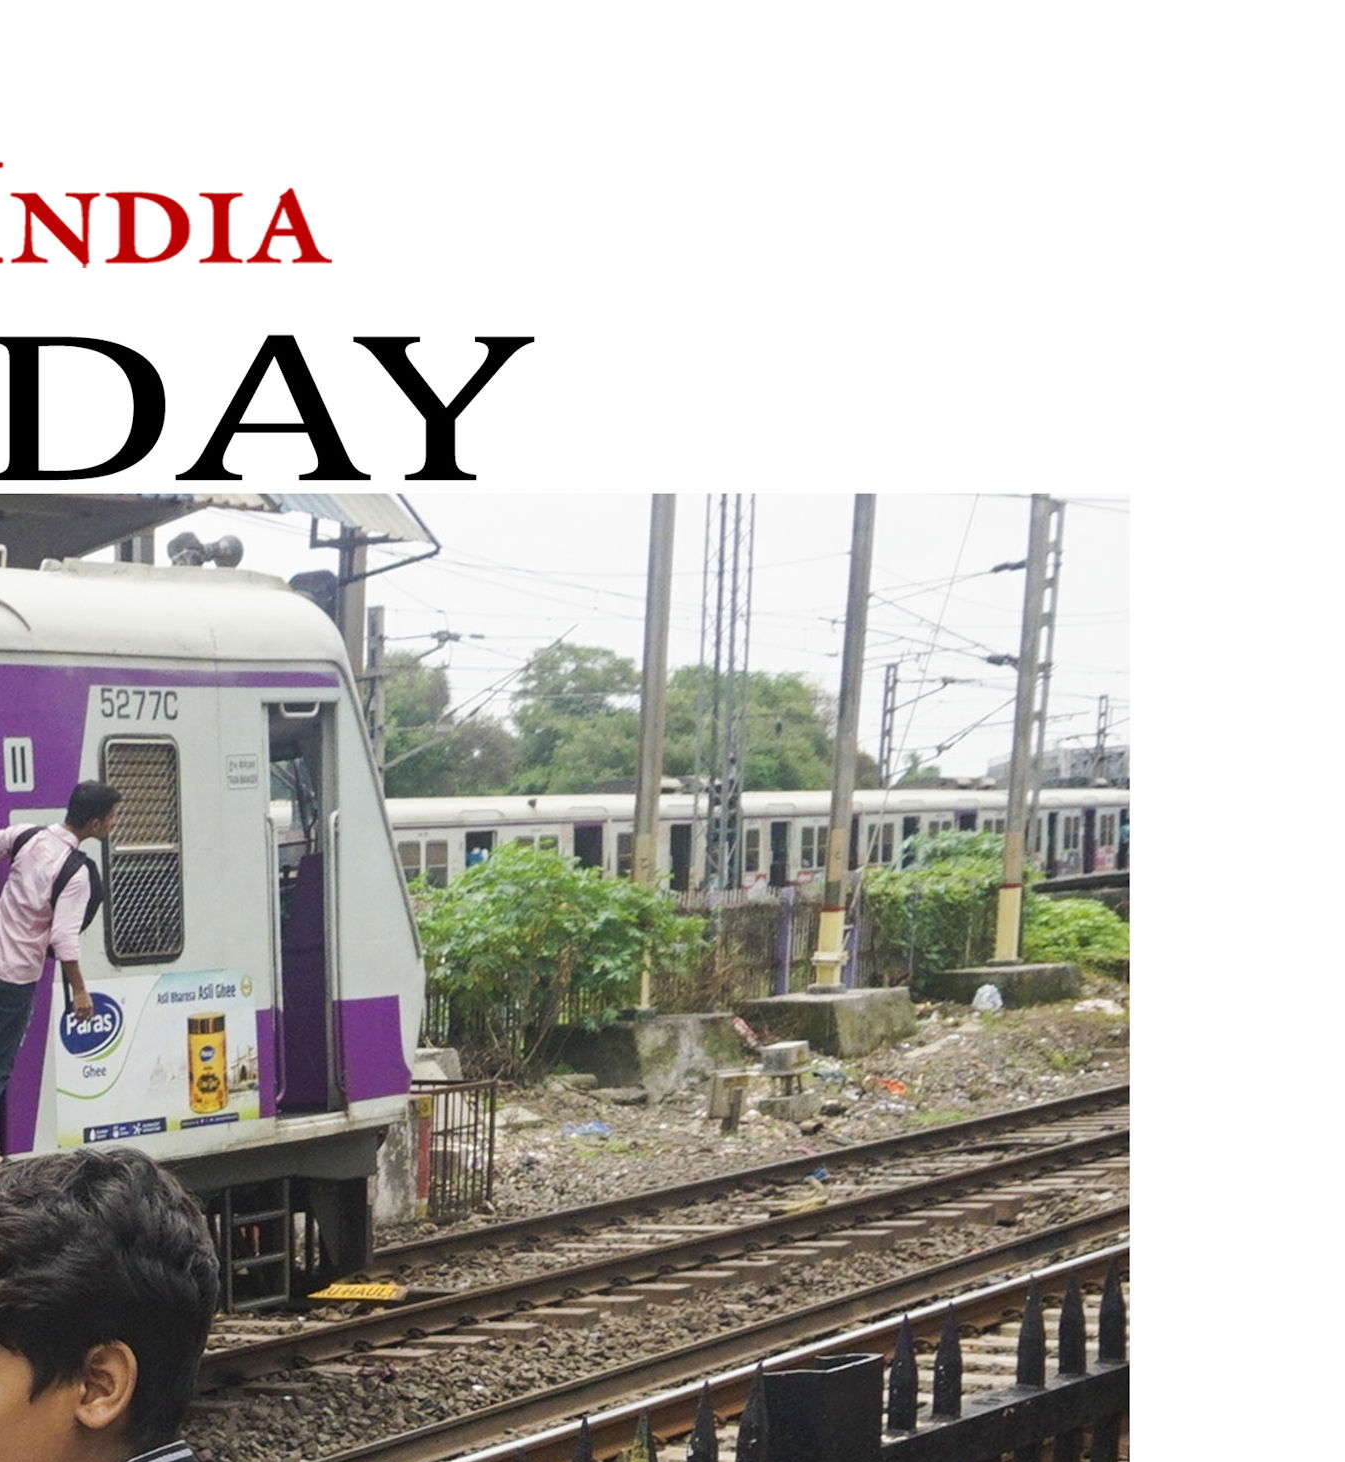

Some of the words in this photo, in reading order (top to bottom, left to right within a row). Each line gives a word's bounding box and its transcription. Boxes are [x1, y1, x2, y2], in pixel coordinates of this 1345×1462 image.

[100, 687, 179, 721] 5277C
[215, 984, 236, 998] Ghee
[82, 1065, 107, 1079] Ghee
